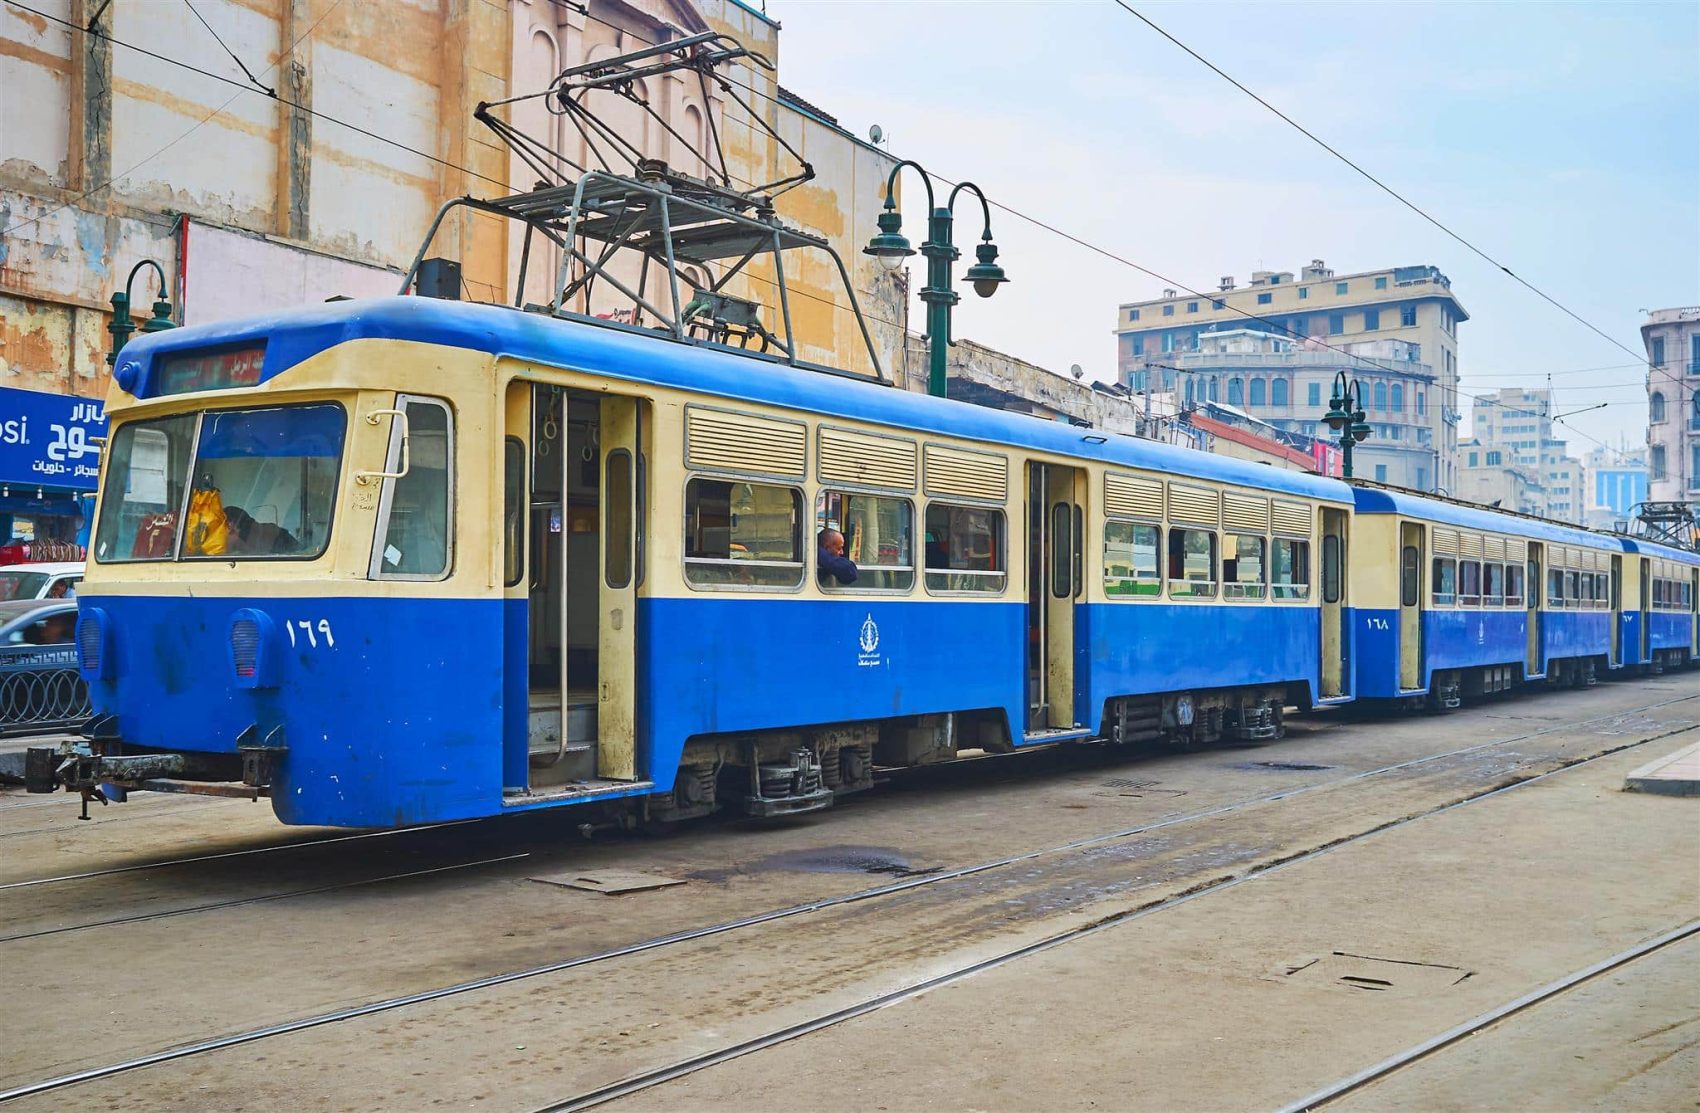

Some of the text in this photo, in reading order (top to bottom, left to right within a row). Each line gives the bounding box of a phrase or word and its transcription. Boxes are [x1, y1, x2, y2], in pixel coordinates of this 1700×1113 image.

[47, 424, 101, 461] وح
[32, 460, 65, 475] حلويات
[286, 619, 334, 648] ١٦٩
[1367, 618, 1388, 630] ١٦٨
